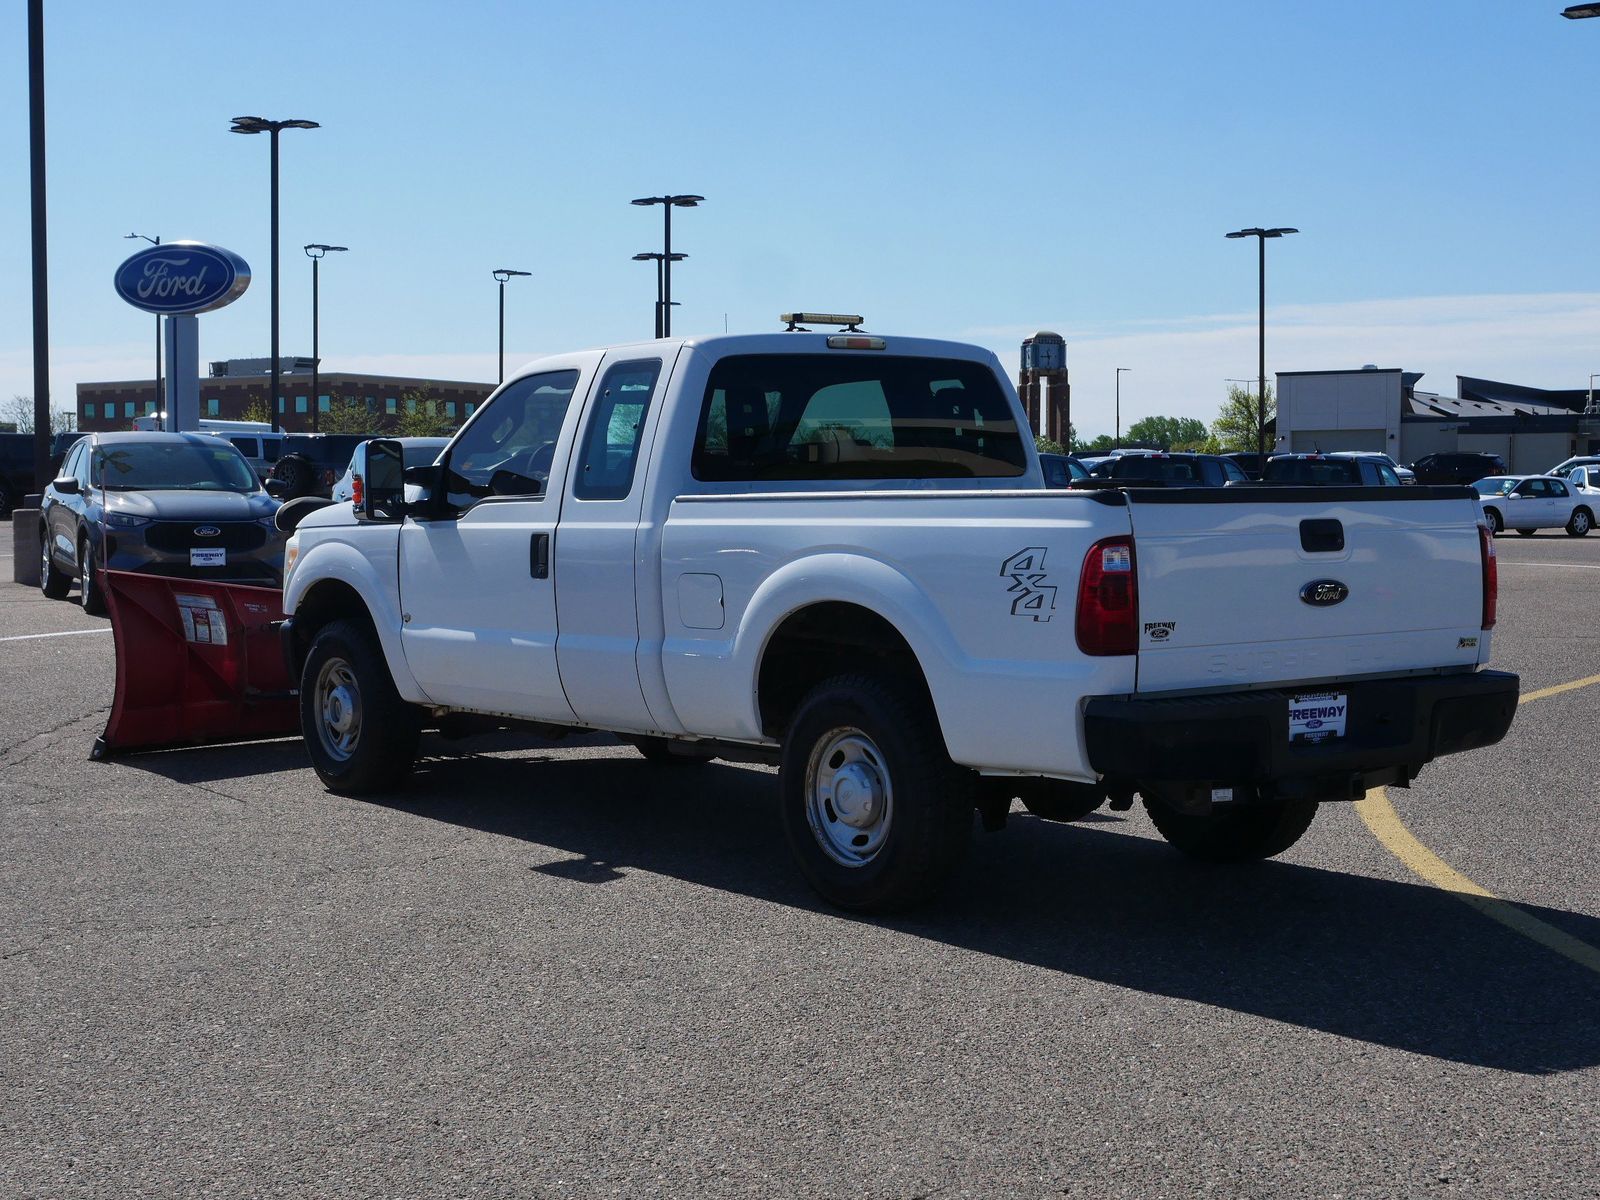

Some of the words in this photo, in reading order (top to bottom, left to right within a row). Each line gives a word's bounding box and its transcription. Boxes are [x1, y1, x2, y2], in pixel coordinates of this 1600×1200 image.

[137, 258, 208, 298] Ford
[1315, 584, 1342, 600] Ford
[1144, 621, 1176, 634] FREEWAY
[1289, 705, 1345, 720] FREEWAY
